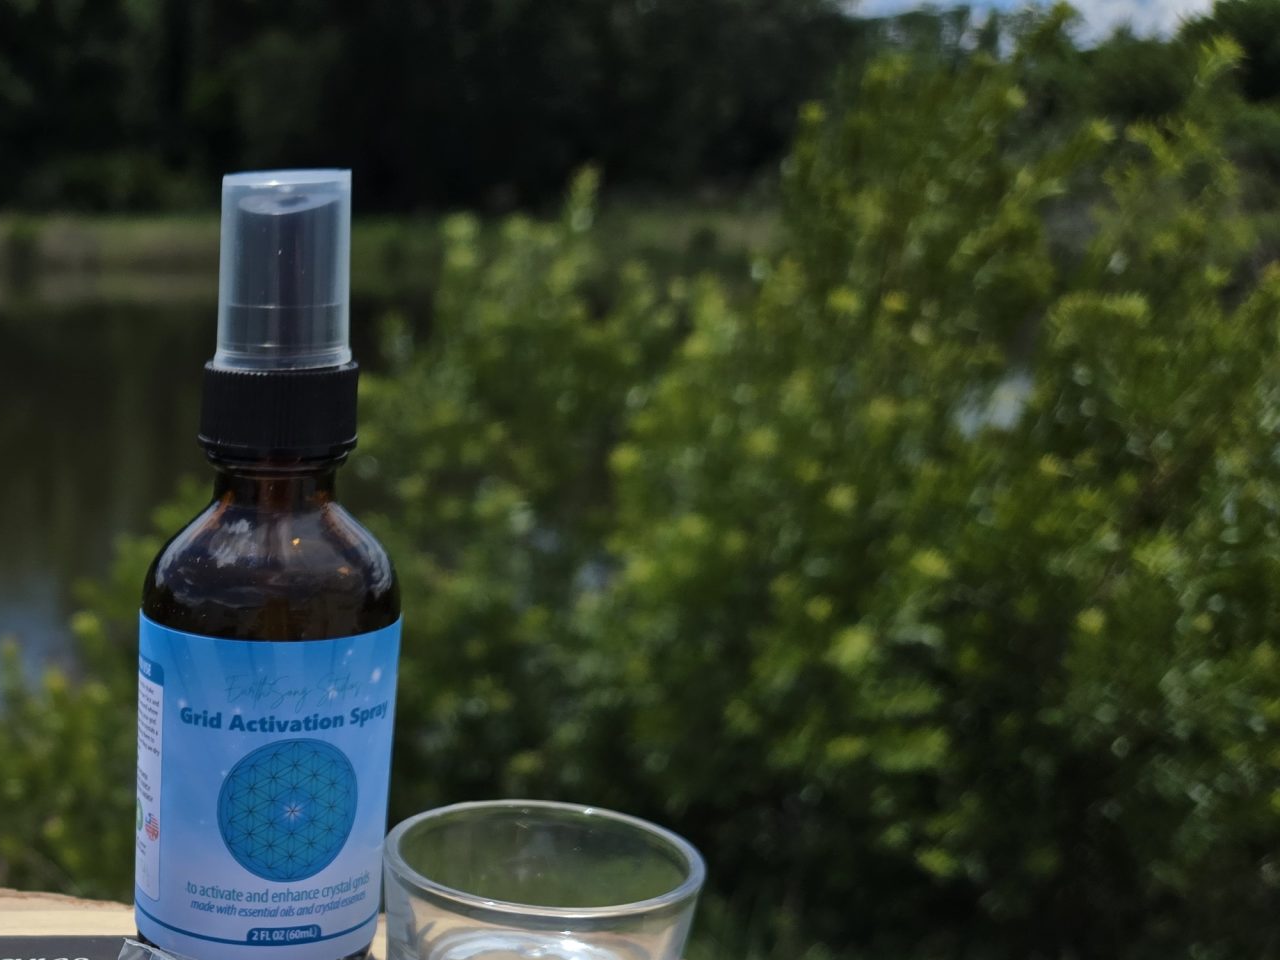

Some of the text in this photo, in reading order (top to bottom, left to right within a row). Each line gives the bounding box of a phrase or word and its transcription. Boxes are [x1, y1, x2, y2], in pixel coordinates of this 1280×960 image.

[180, 707, 222, 729] Grid
[229, 713, 344, 733] Activation
[350, 700, 388, 728] Spray
[186, 871, 369, 903] to activate and enhance crystal grids
[190, 900, 215, 913] made
[216, 903, 237, 917] with
[238, 904, 280, 918] essential
[280, 906, 295, 918] oils
[297, 902, 315, 916] and
[315, 897, 340, 915] crystal
[251, 926, 318, 941] 2 FL OZ (60mL)
